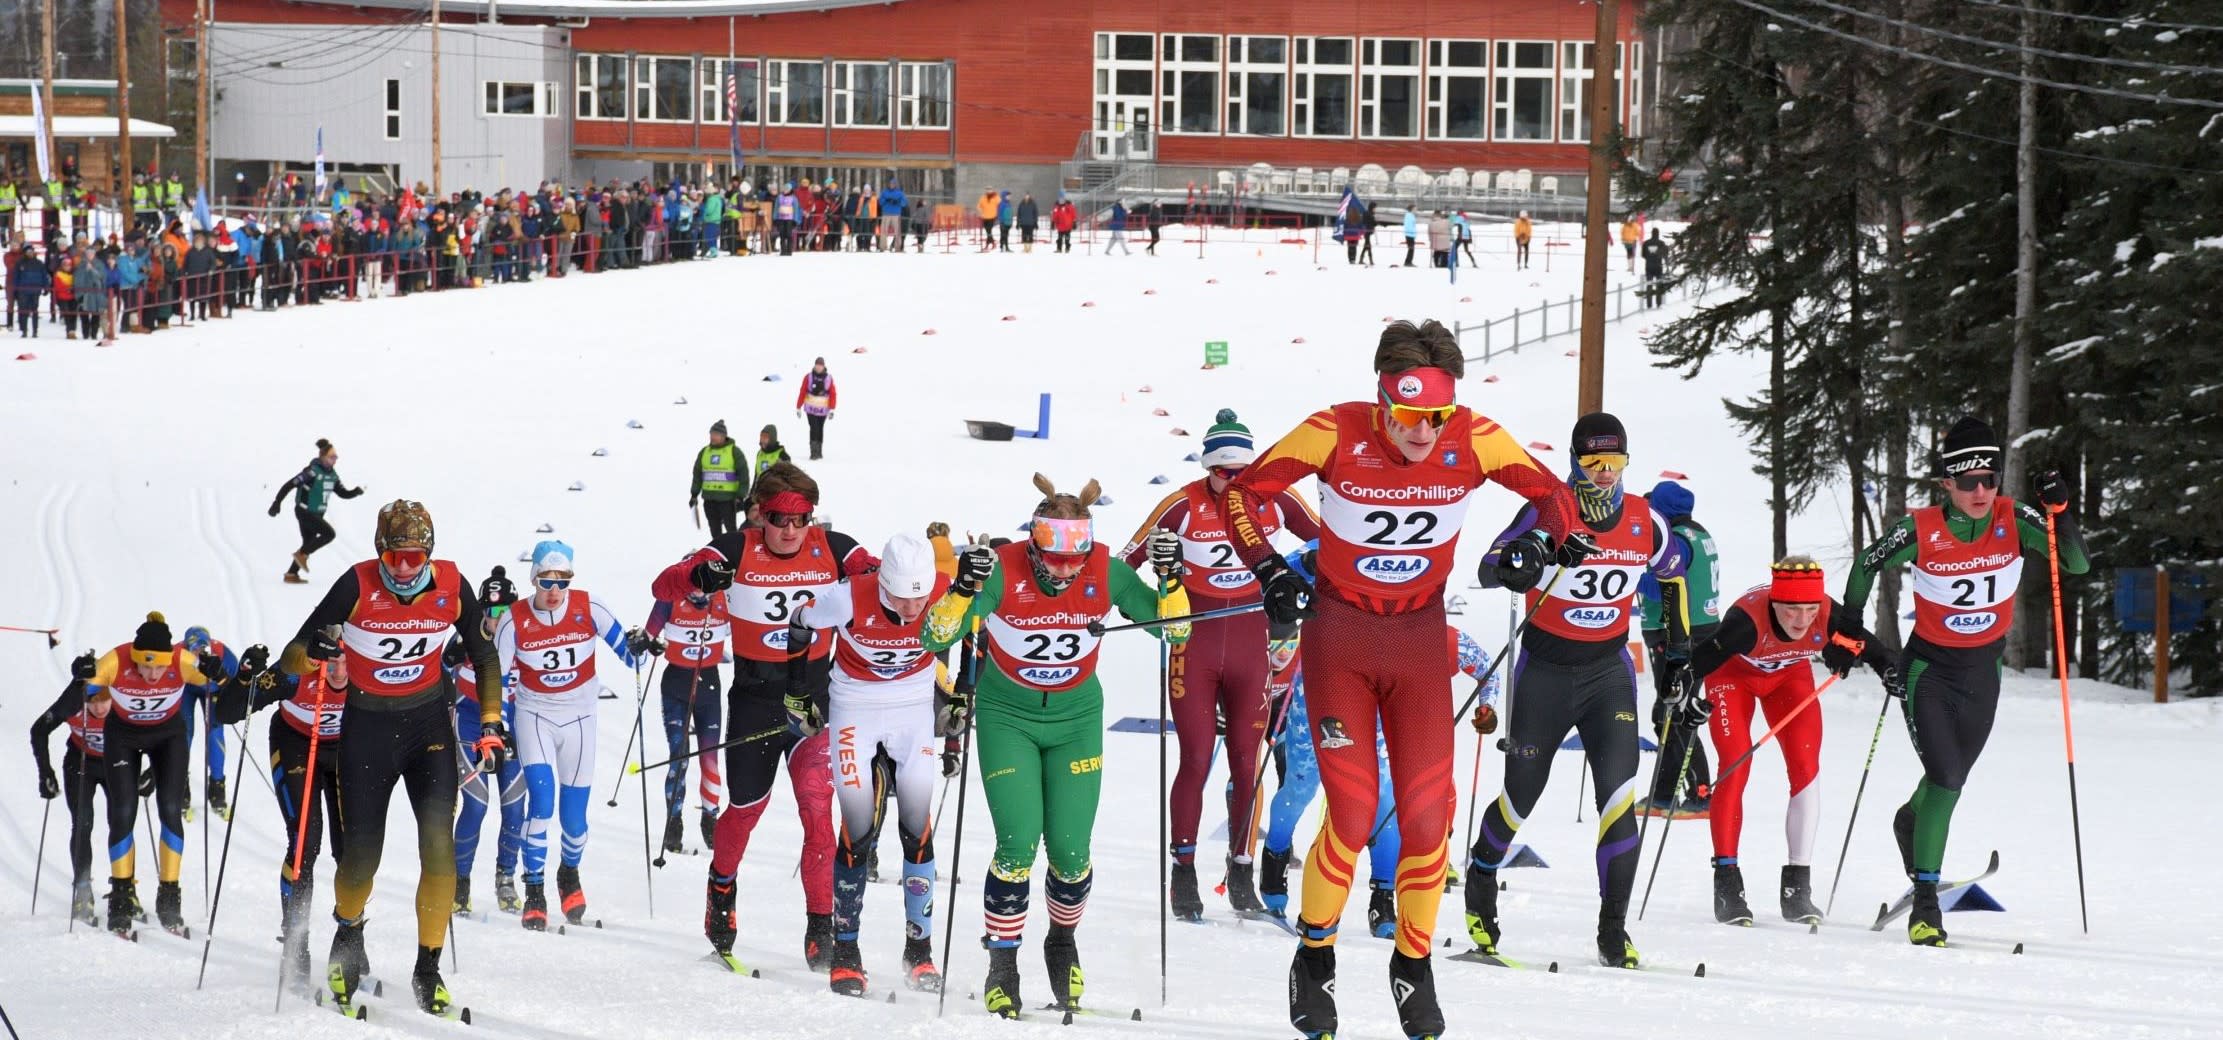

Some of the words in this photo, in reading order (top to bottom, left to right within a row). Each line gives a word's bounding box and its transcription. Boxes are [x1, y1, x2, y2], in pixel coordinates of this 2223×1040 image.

[1340, 481, 1465, 500] ConocoPhillips
[1228, 490, 1246, 517] WEST
[1234, 516, 1262, 547] VALLE
[1363, 511, 1438, 545] 22
[1209, 543, 1234, 568] 2
[1583, 548, 1648, 562] ocoPhillips
[1926, 552, 2014, 571] ConocoPhillips
[1364, 558, 1422, 572] ASAA
[745, 571, 831, 582] ConocoPhillips
[1214, 572, 1252, 583] ASAA
[1570, 570, 1629, 600] 30
[1951, 575, 1997, 607] 21
[1005, 612, 1102, 627] ConocoPhillips
[1570, 609, 1616, 620] ASAA
[1950, 614, 1992, 627] ASAA
[361, 619, 448, 631] ConocoPhillips
[674, 618, 725, 626] ConocoPillips
[522, 632, 590, 649] ConocoPhillips
[769, 633, 790, 643] AS
[853, 634, 920, 647] ConocoPh
[378, 637, 428, 660] 24
[1023, 634, 1081, 661] 23
[542, 648, 576, 670] 31
[380, 667, 420, 678] ASAA
[543, 673, 574, 683] ASAA
[1024, 669, 1073, 681] ASAA
[129, 697, 168, 711] 37
[320, 713, 338, 726] 2
[838, 726, 861, 789] WEST
[1069, 754, 1103, 775] SERV
